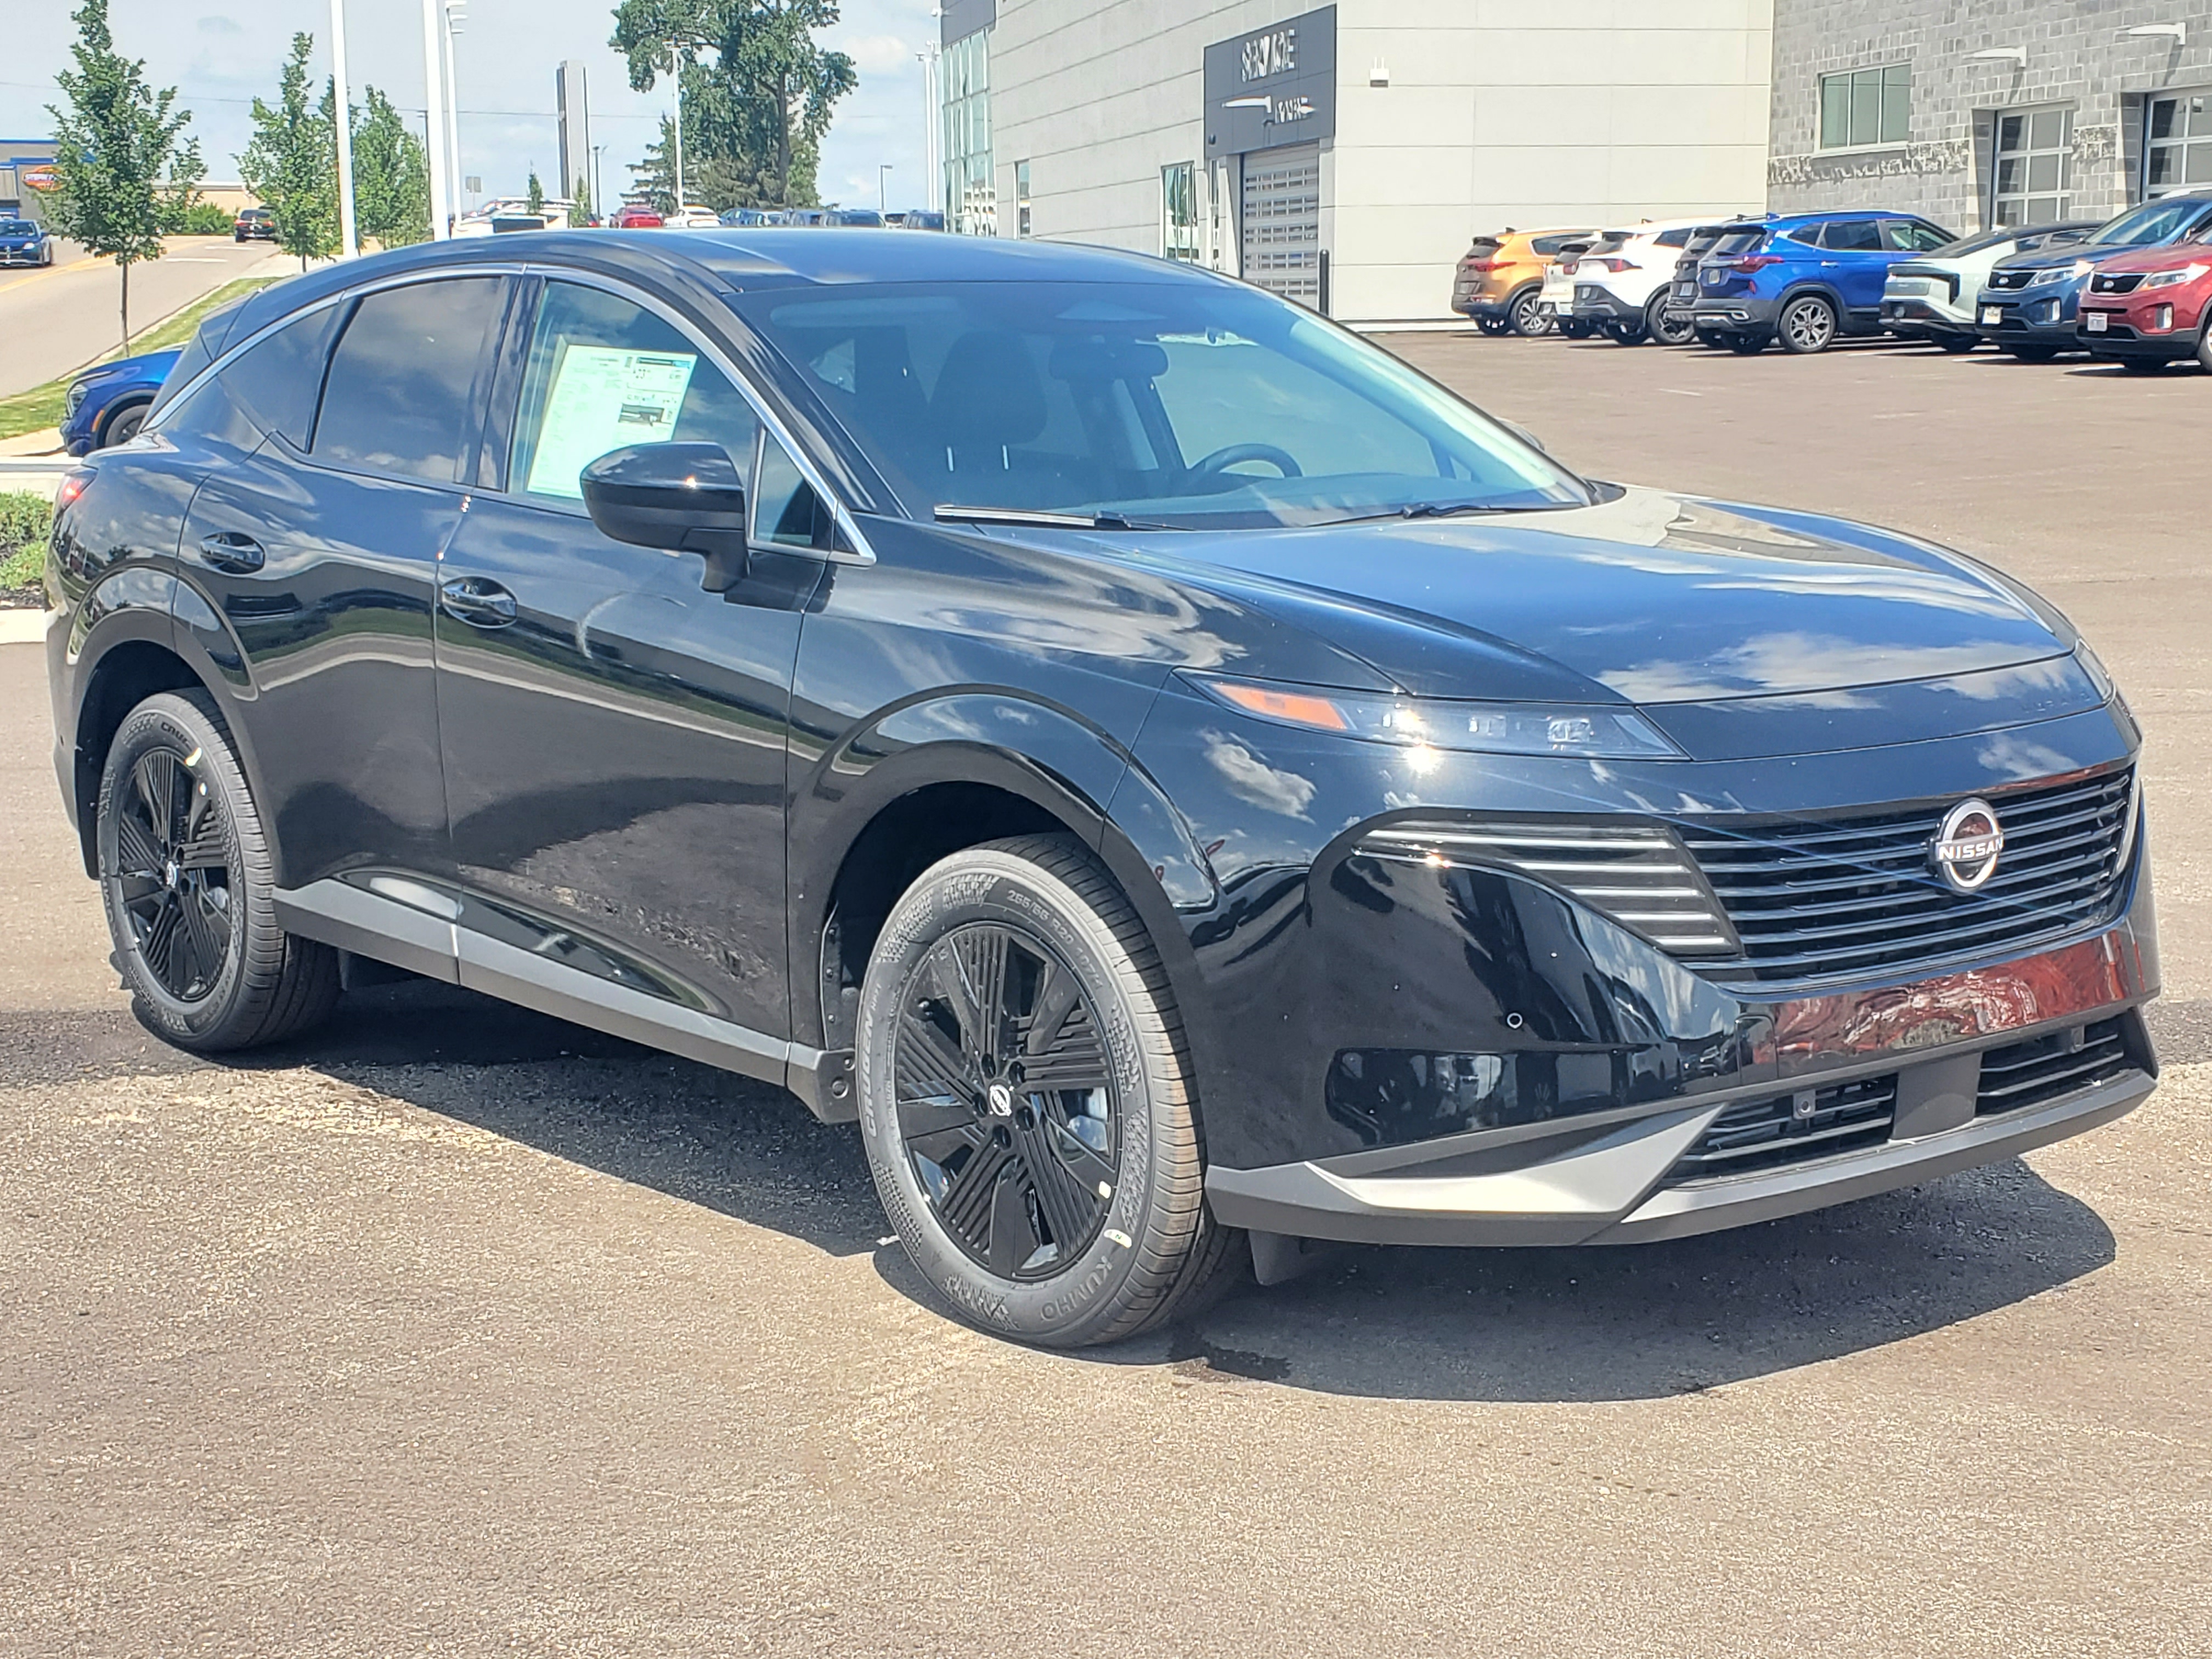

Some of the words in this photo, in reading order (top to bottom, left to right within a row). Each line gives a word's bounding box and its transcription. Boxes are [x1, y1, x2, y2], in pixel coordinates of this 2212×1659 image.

[1938, 837, 2004, 860] NISSAN
[1051, 917, 1074, 945] R20
[862, 1009, 877, 1138] CRUGEN
[1040, 1255, 1113, 1322] KUMHO
